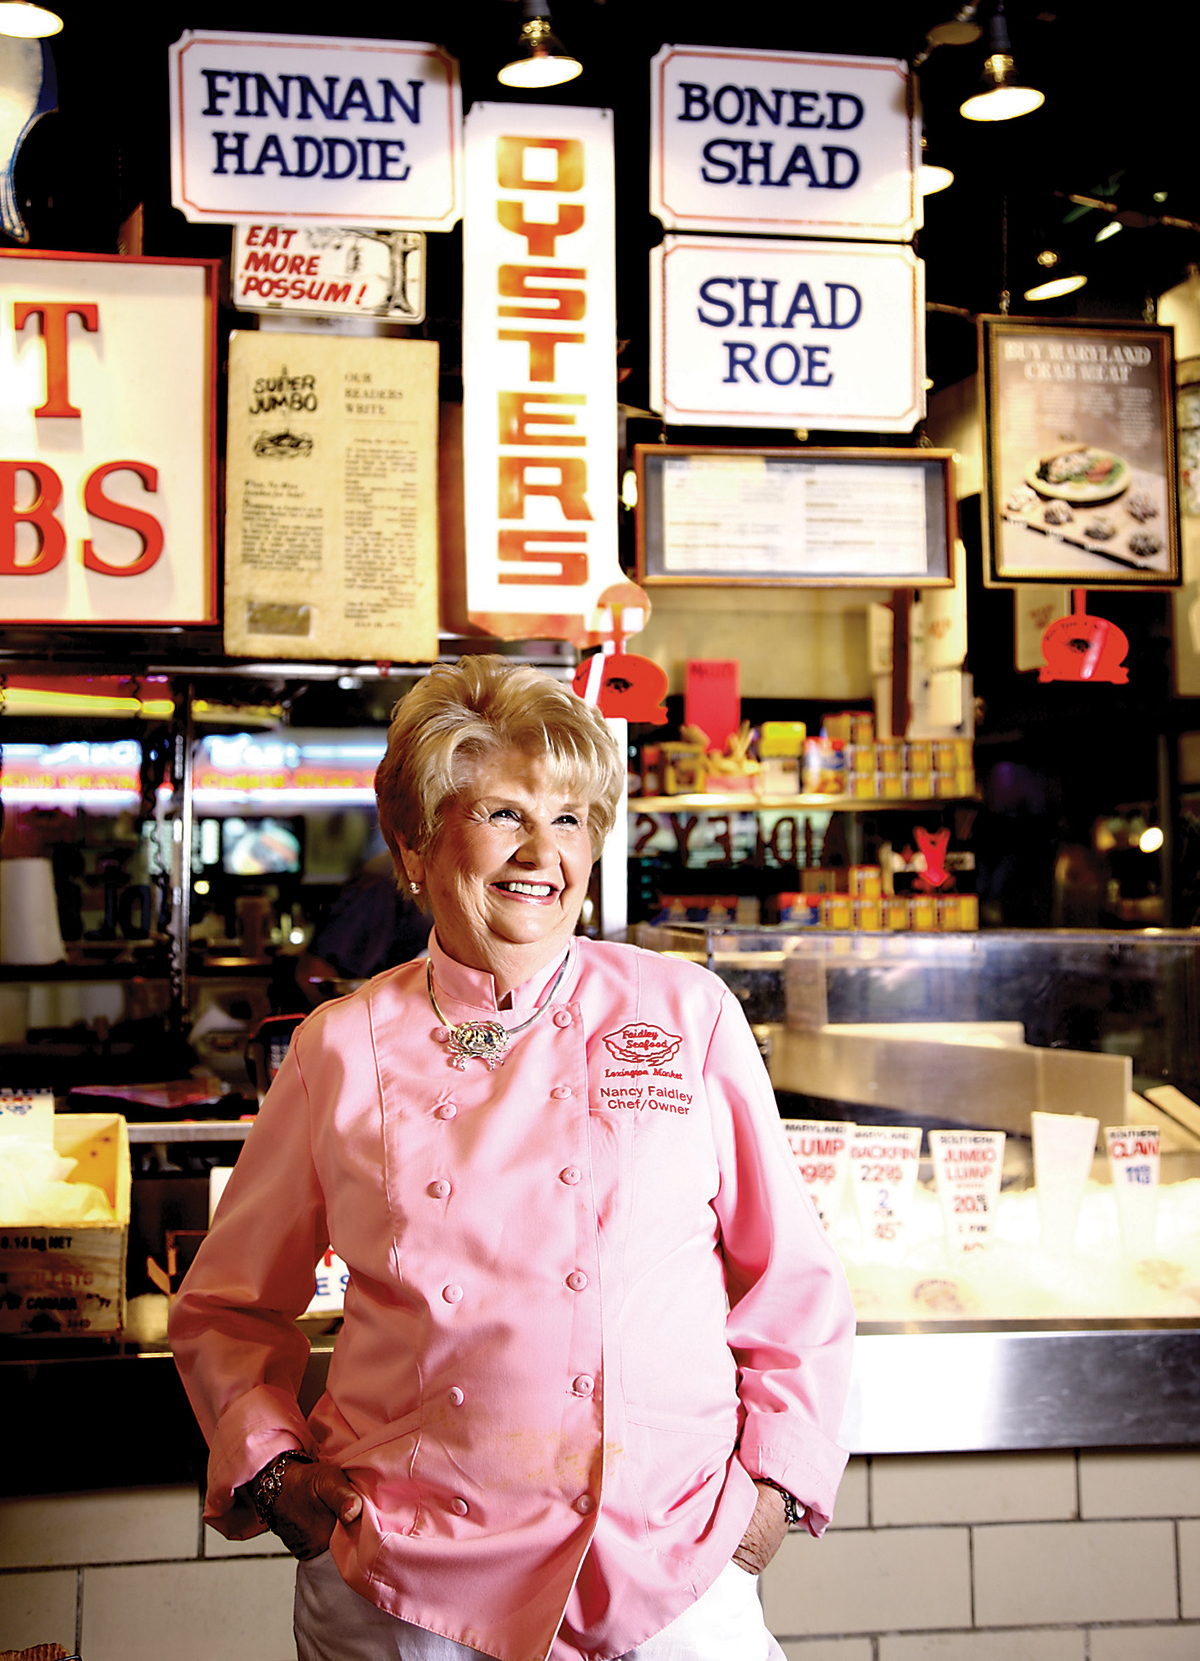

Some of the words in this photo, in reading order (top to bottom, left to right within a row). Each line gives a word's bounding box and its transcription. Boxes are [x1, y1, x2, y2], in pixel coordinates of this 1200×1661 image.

[201, 69, 424, 124] FINNAN
[678, 82, 865, 130] BONED
[212, 132, 411, 181] HADDIE
[701, 139, 860, 189] SHAD
[246, 225, 298, 249] EAT
[244, 252, 321, 276] MORE
[697, 277, 862, 330] SHAD
[497, 135, 594, 586] OYSTERS
[723, 341, 834, 387] ROE
[253, 372, 317, 394] SUPER
[249, 391, 319, 415] JUMBO
[622, 1029, 658, 1041] Faidley
[625, 1040, 668, 1051] Seafood
[652, 1067, 684, 1080] Market
[600, 1087, 643, 1098] Nancy
[647, 1085, 693, 1104] Faidley
[607, 1098, 690, 1115] Chef/Owner
[785, 1123, 845, 1134] MARYLAND
[944, 1148, 997, 1163] JUMBO
[49, 1236, 72, 1249] NET
[26, 1297, 77, 1311] CANADA
